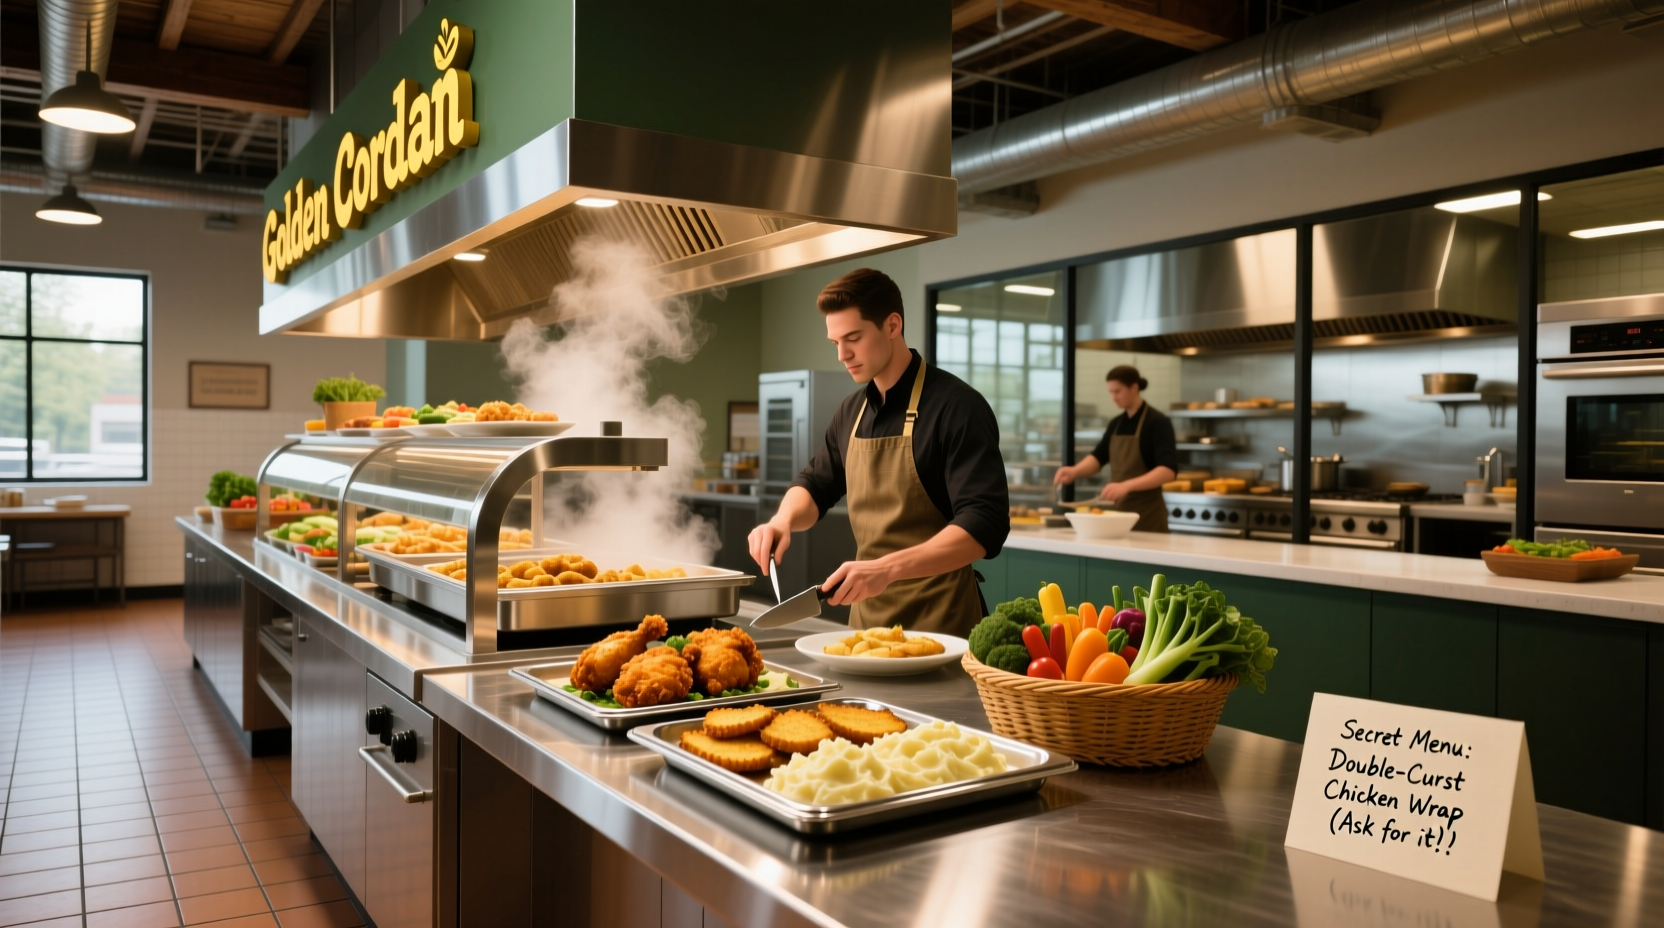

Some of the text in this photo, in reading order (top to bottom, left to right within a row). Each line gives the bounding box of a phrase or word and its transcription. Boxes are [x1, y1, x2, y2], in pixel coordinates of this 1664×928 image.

[262, 67, 466, 284] Golden Cordan
[1340, 719, 1472, 759] Secret Menu:
[1328, 747, 1466, 792] Double-Curst
[1324, 778, 1464, 830] Chicken Wrap
[1329, 807, 1375, 837] (Ask
[1381, 818, 1411, 844] for
